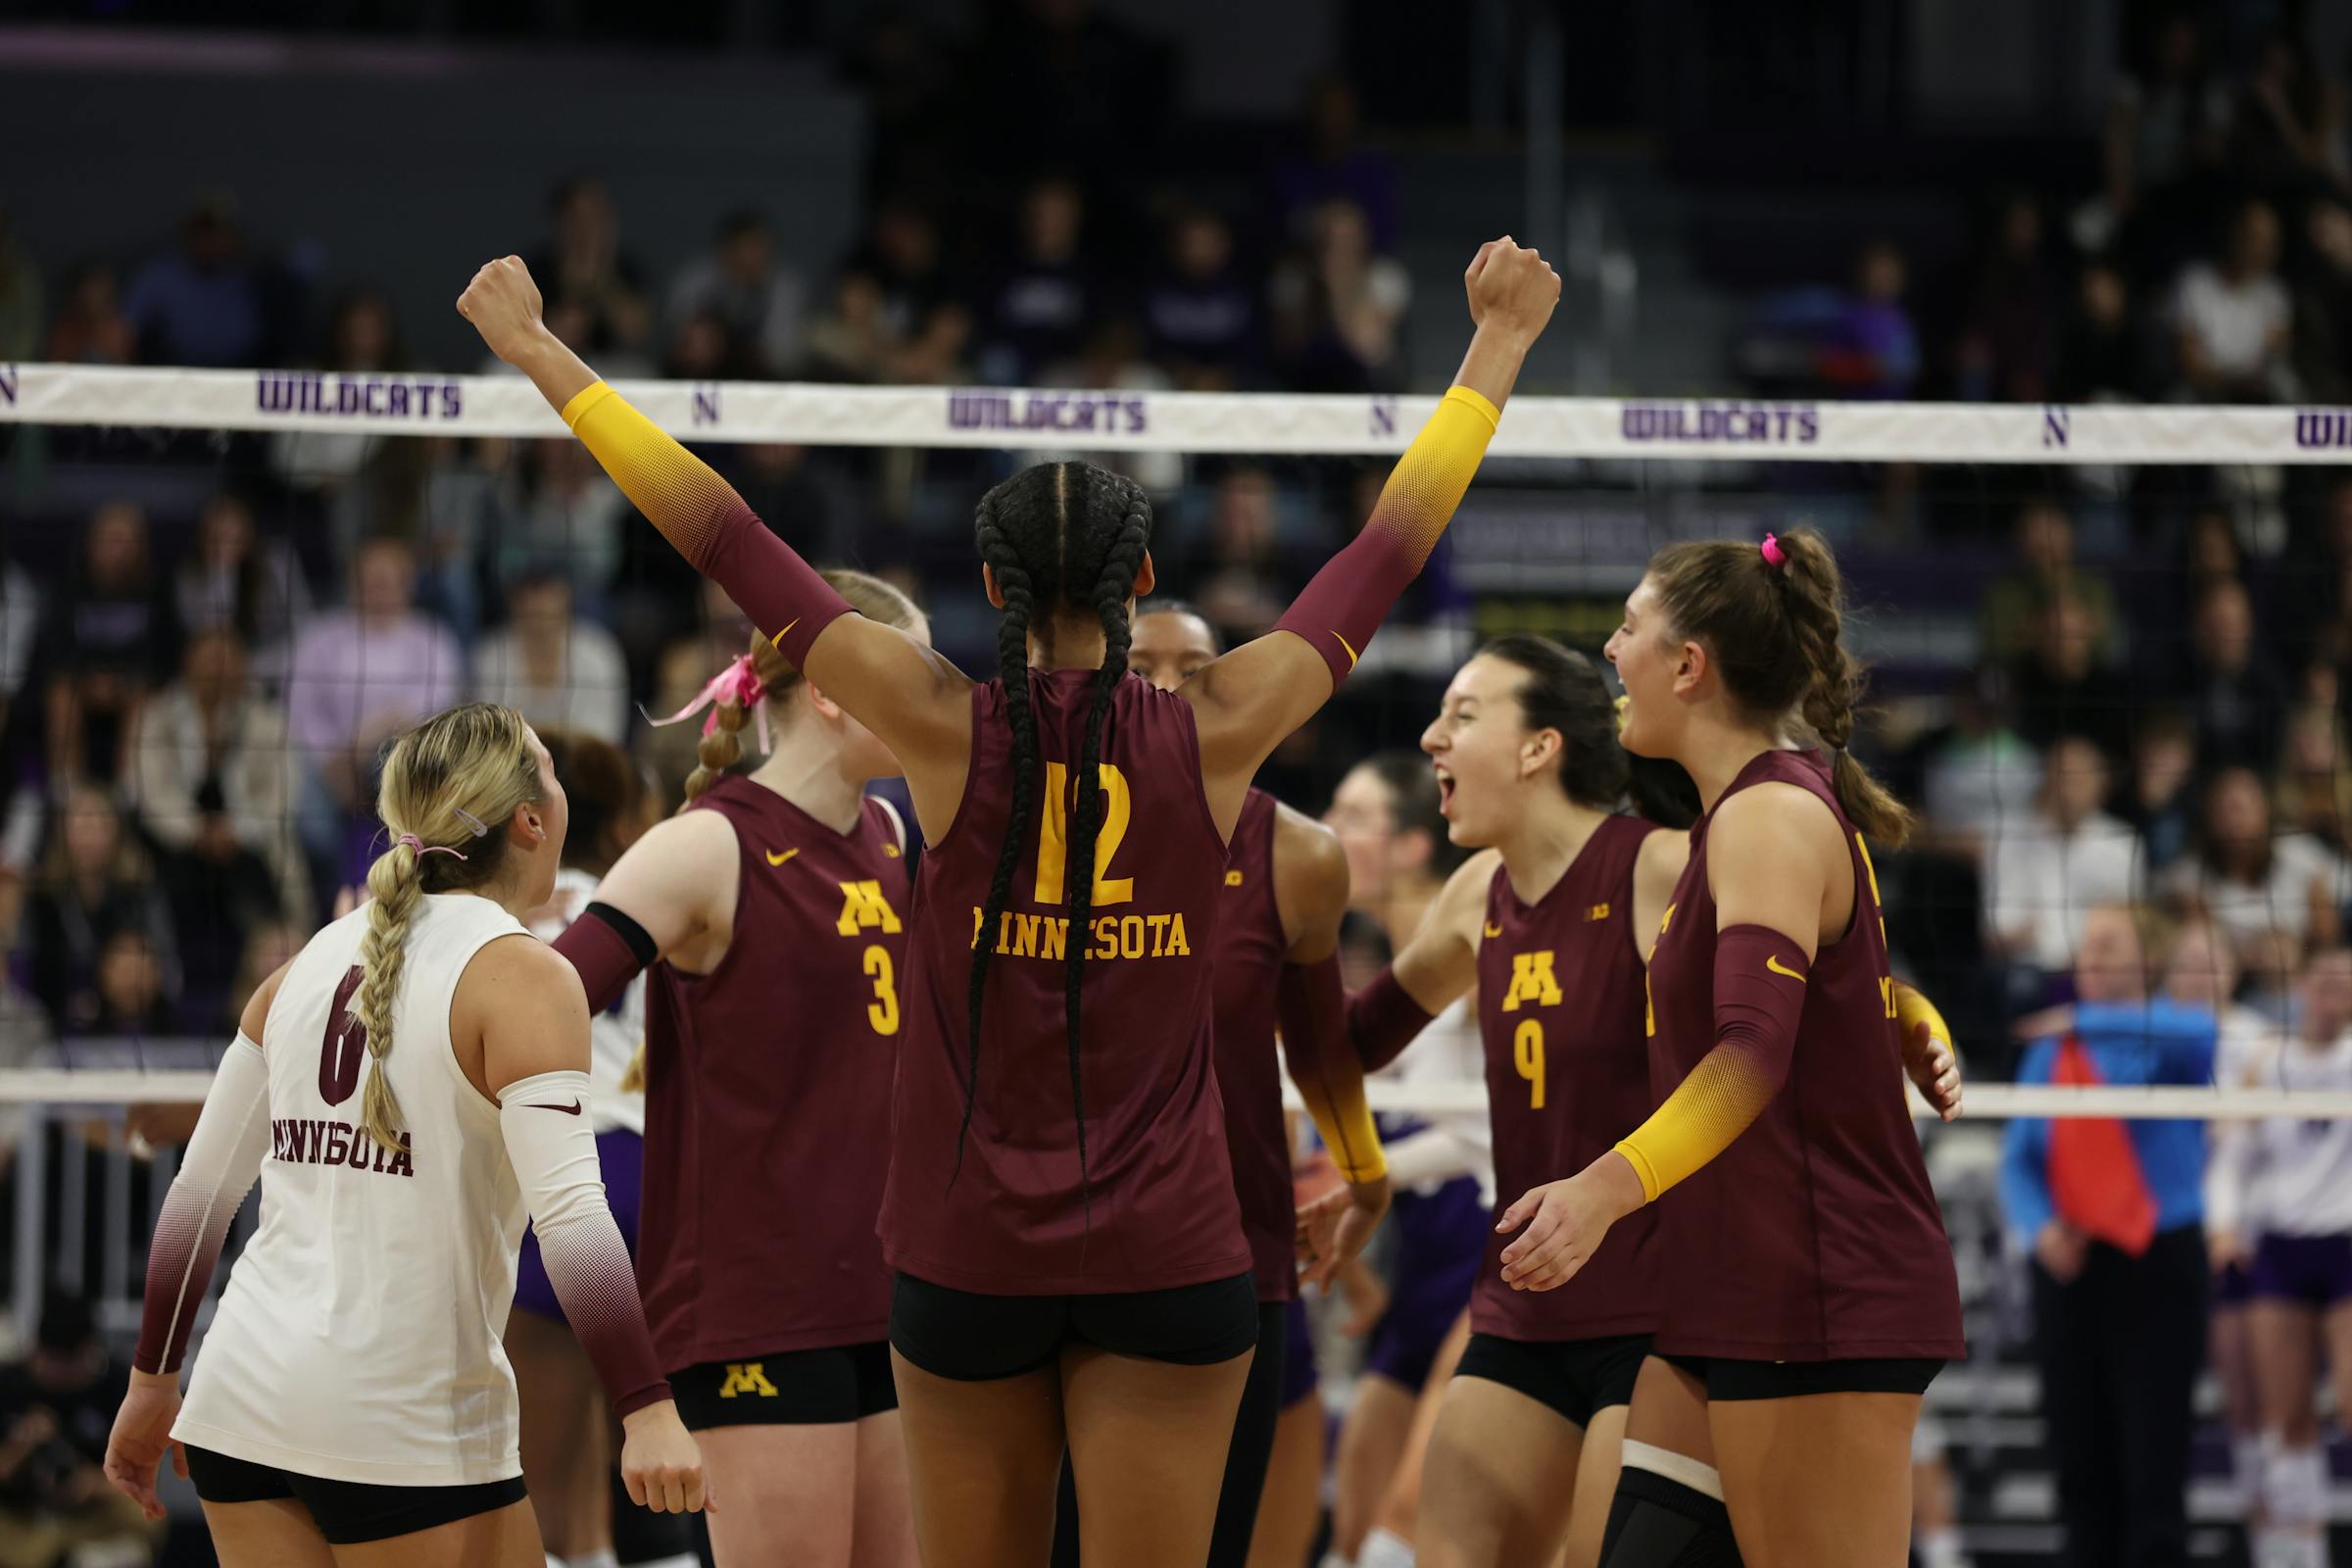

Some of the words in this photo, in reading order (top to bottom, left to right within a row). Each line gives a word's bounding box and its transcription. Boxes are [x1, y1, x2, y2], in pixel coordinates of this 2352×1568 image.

[258, 372, 466, 418] WILDCATS
[692, 383, 720, 428] N
[948, 389, 1147, 433] WILDCATS
[1371, 397, 1396, 438] N
[1623, 400, 1819, 443] WILDCATS
[2043, 407, 2069, 449] N
[1034, 760, 1135, 907] 12
[836, 879, 903, 936] M
[862, 945, 901, 1035] 3
[1501, 949, 1563, 1012] M
[318, 964, 368, 1107] 6
[1514, 1018, 1545, 1109] 9
[719, 1363, 779, 1398] M
